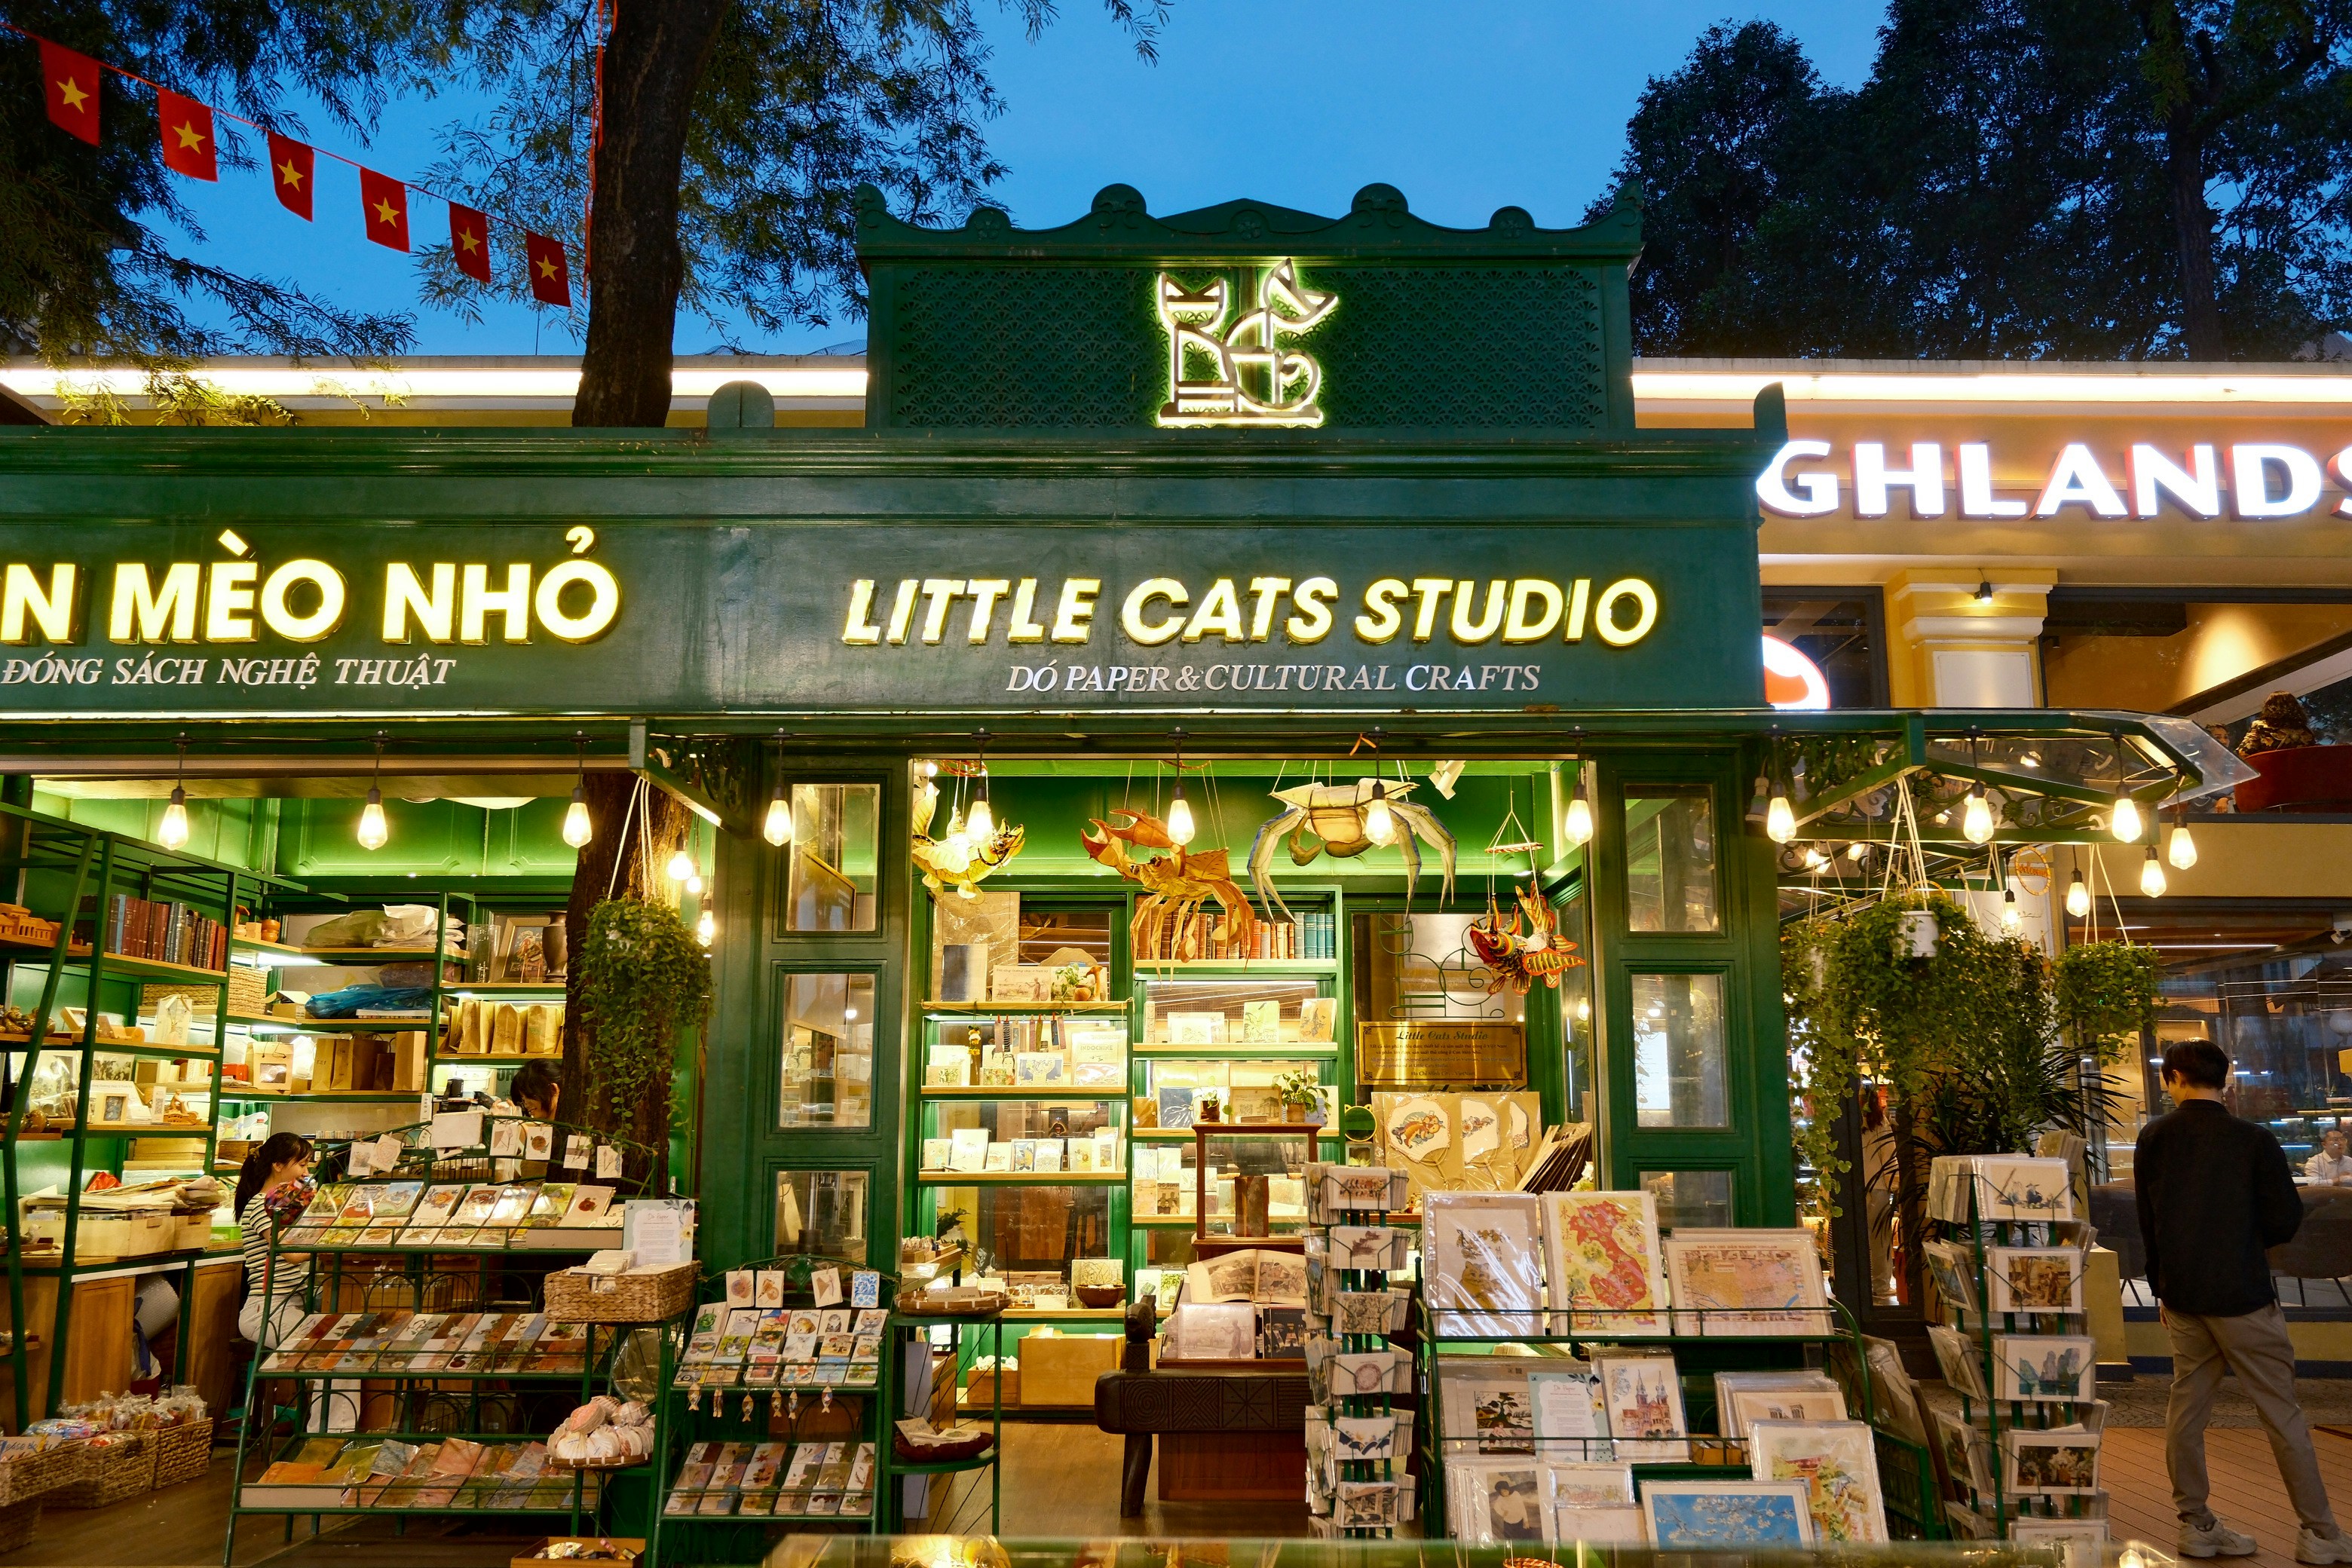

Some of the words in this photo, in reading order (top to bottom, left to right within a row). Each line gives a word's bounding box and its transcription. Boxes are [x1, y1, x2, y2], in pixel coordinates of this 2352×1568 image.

[1756, 440, 2352, 518] GHLAND
[109, 529, 347, 643] MÈO
[382, 526, 621, 643] NHỎ
[841, 578, 1101, 645] LITTLE
[1122, 577, 1339, 645] CATS
[1355, 578, 1658, 646] STUDIO
[2, 651, 103, 684] ĐÓNG
[112, 651, 208, 684] SÁCH
[216, 652, 321, 690] NGHỆ
[335, 653, 457, 690] THUẬT
[1006, 659, 1057, 692] DÓ
[1064, 666, 1170, 692] PAPER
[1204, 664, 1396, 691] CULTURAL
[1406, 665, 1540, 691] CRAFTS
[1395, 1031, 1425, 1040] Little
[1428, 1031, 1450, 1040] Cats
[1453, 1031, 1489, 1040] Studio
